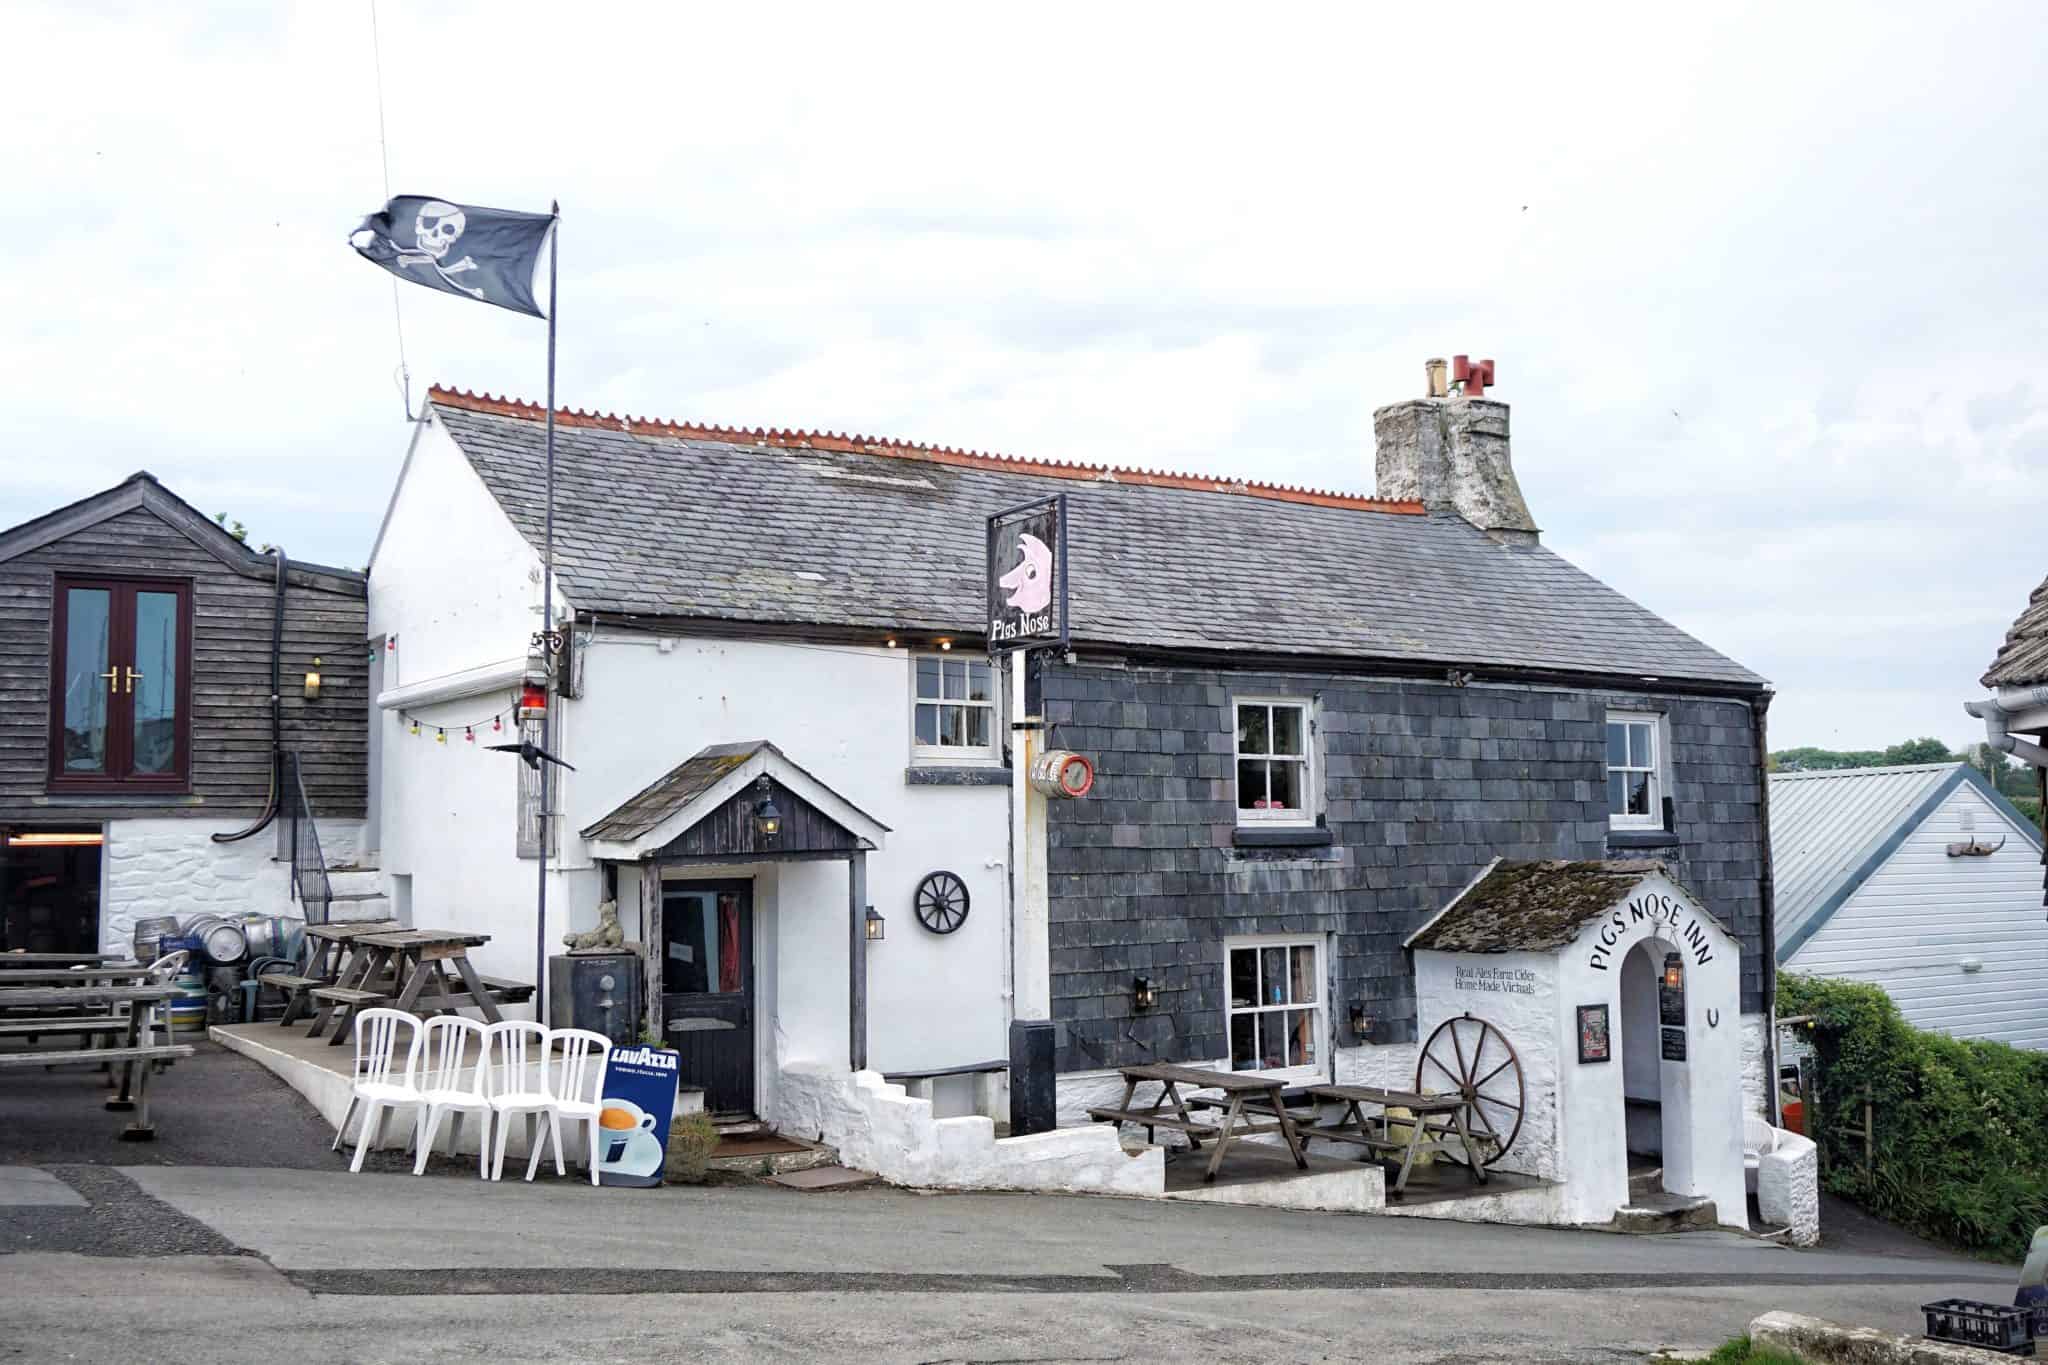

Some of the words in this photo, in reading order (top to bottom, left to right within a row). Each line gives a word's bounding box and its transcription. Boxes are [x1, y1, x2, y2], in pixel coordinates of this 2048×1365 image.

[991, 620, 1017, 641] Pigs
[1020, 613, 1049, 635] Nose
[1590, 911, 1626, 970] PIGS
[1628, 893, 1683, 927] NOSE
[1684, 919, 1713, 966] INN
[1455, 966, 1474, 978] Real
[1476, 967, 1492, 978] Ales
[1493, 967, 1513, 980] Farm
[1514, 968, 1536, 982] Cider
[1455, 977, 1477, 990] Home
[1478, 979, 1501, 992] Made
[610, 1047, 677, 1069] LAVAZZA
